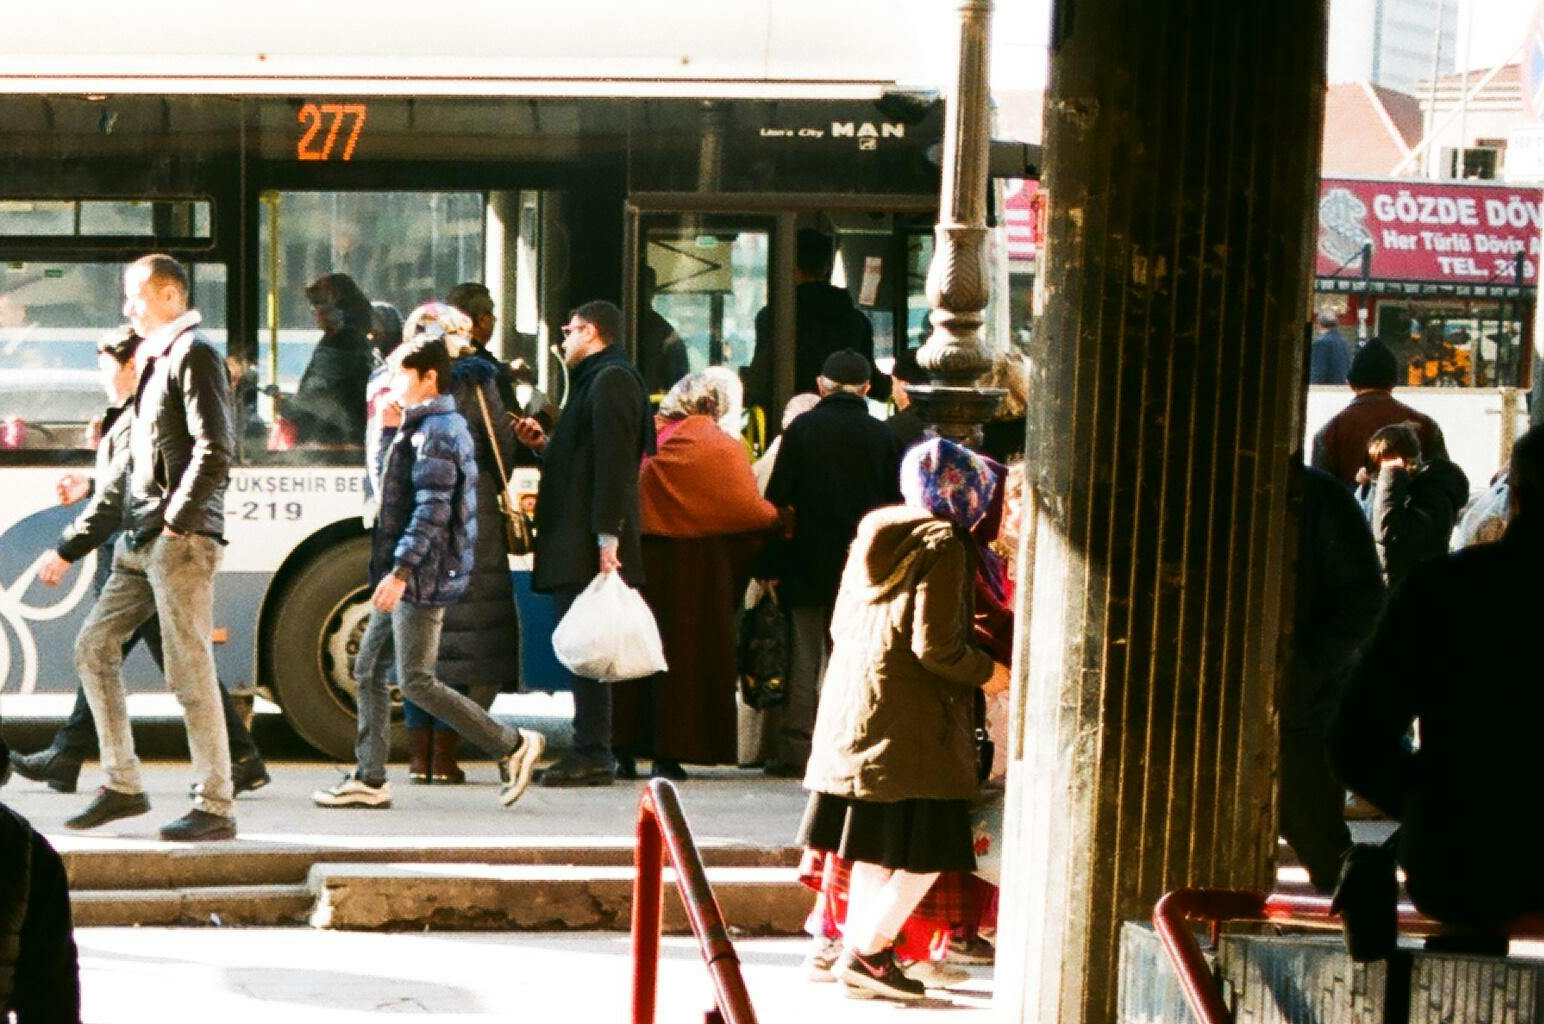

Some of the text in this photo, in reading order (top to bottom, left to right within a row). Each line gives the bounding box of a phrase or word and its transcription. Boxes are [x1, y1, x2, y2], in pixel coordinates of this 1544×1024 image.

[298, 103, 366, 161] 277
[798, 128, 824, 138] City
[831, 122, 905, 138] MAN
[1373, 189, 1480, 226] GÖZDE
[1381, 229, 1418, 250] Her
[1420, 231, 1470, 251] Türlü
[1437, 256, 1489, 276] TEL.
[229, 471, 365, 495] ÜKŞEHİR BE
